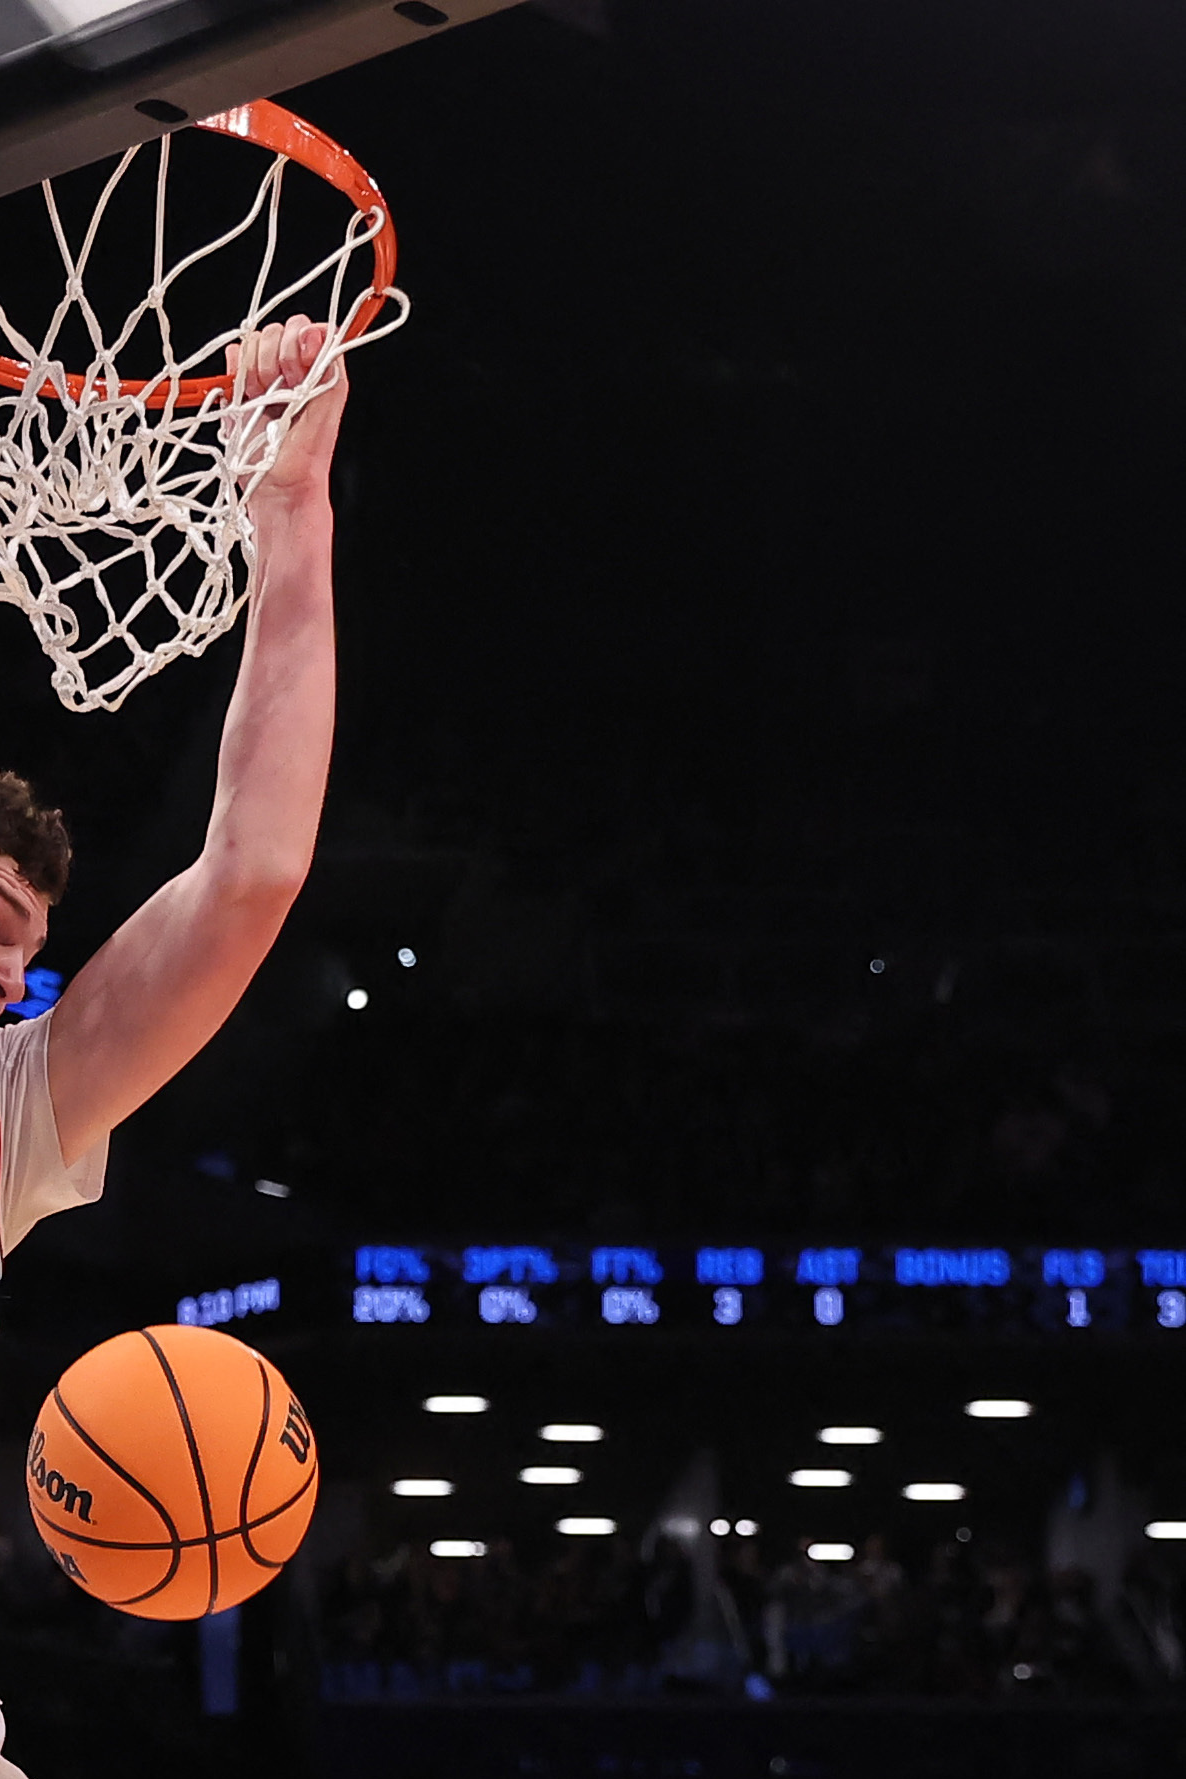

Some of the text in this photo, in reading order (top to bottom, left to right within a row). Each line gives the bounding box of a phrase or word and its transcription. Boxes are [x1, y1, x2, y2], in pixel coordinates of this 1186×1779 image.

[715, 1287, 743, 1325] 3
[1068, 1288, 1092, 1327] 1
[27, 1427, 93, 1524] lson
